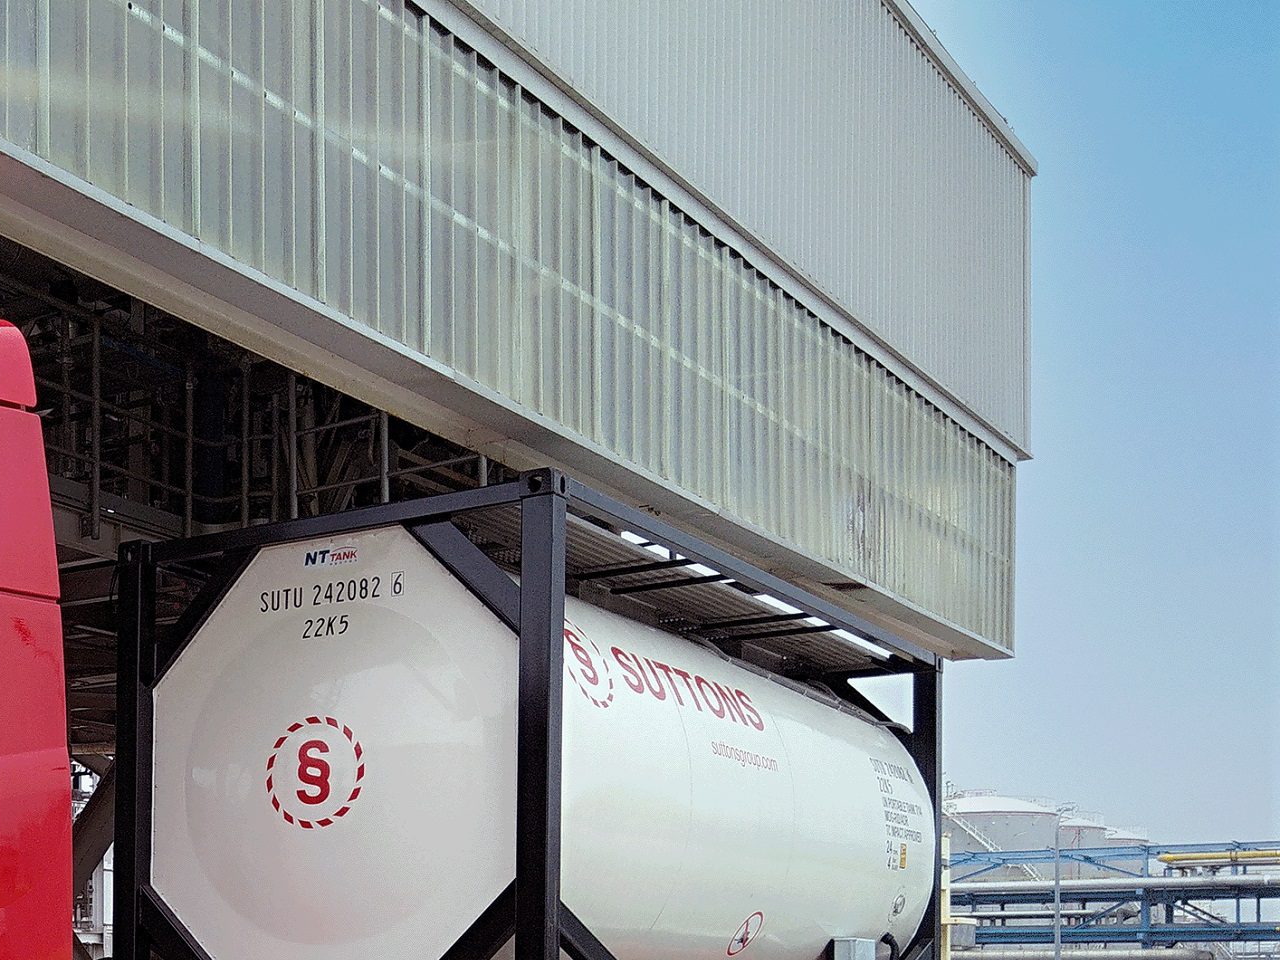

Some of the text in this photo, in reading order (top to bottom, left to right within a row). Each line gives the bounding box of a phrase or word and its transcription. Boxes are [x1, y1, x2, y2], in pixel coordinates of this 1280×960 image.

[260, 587, 303, 613] SUTU
[312, 576, 381, 606] 242082
[302, 614, 349, 640] 22K5
[610, 646, 765, 732] SUTTONS
[711, 740, 780, 773] suttonsgroup.com
